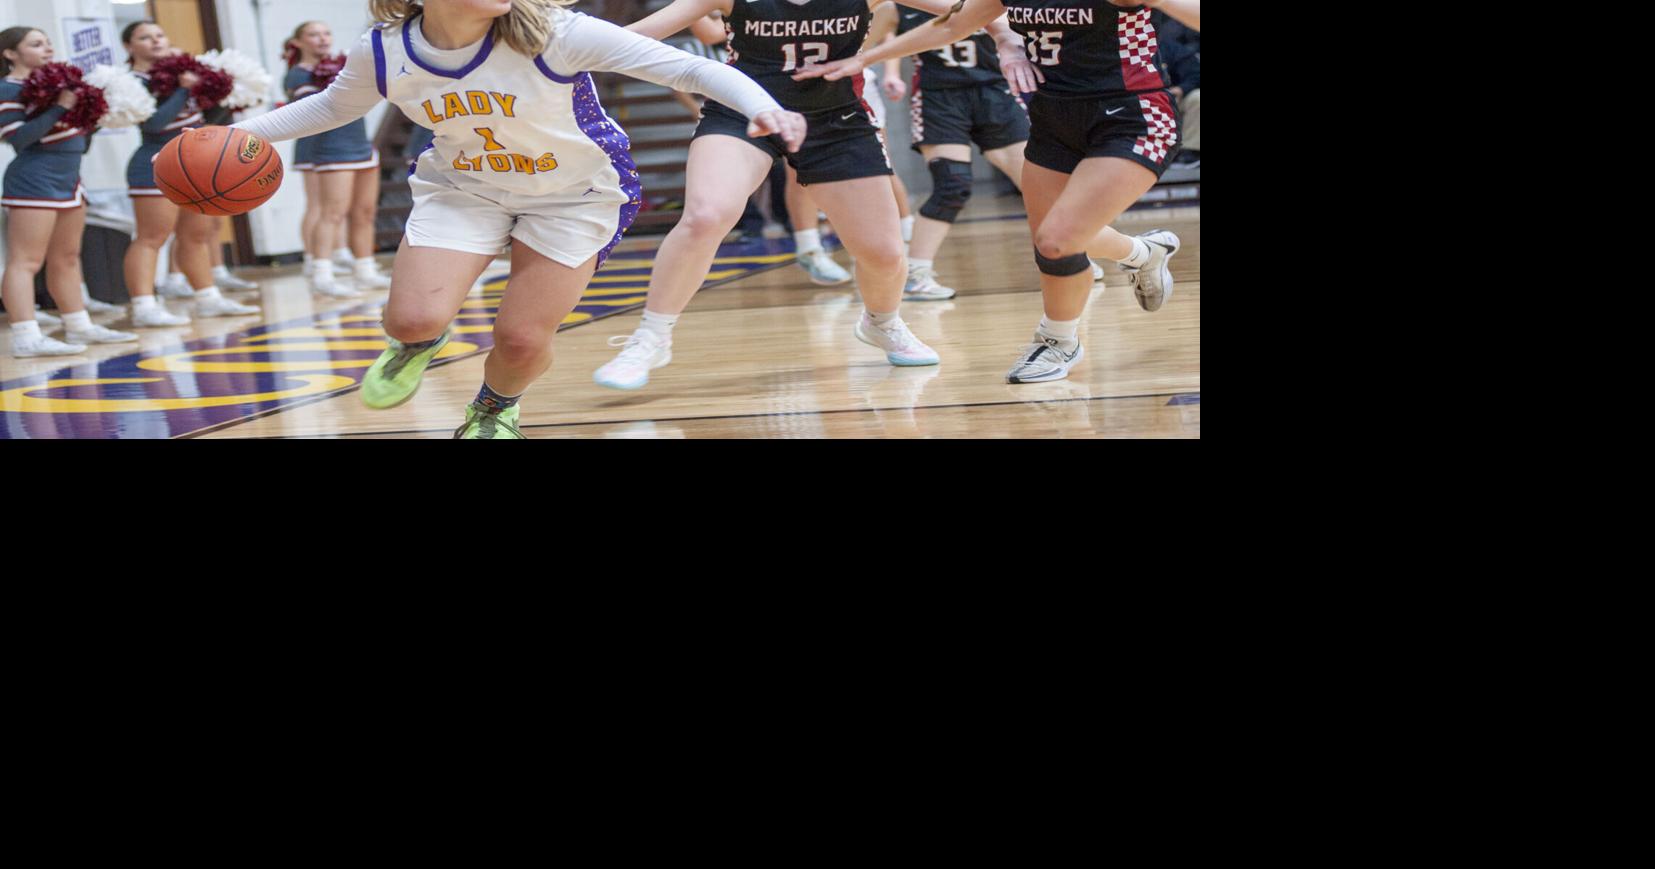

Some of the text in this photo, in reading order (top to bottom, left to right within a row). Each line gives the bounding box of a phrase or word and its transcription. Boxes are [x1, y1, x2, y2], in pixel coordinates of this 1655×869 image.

[744, 15, 860, 37] MCCRACKEN
[1006, 6, 1094, 25] CCRACKEN
[421, 90, 517, 124] LADY
[473, 127, 506, 151] 1
[452, 150, 559, 175] LYONS
